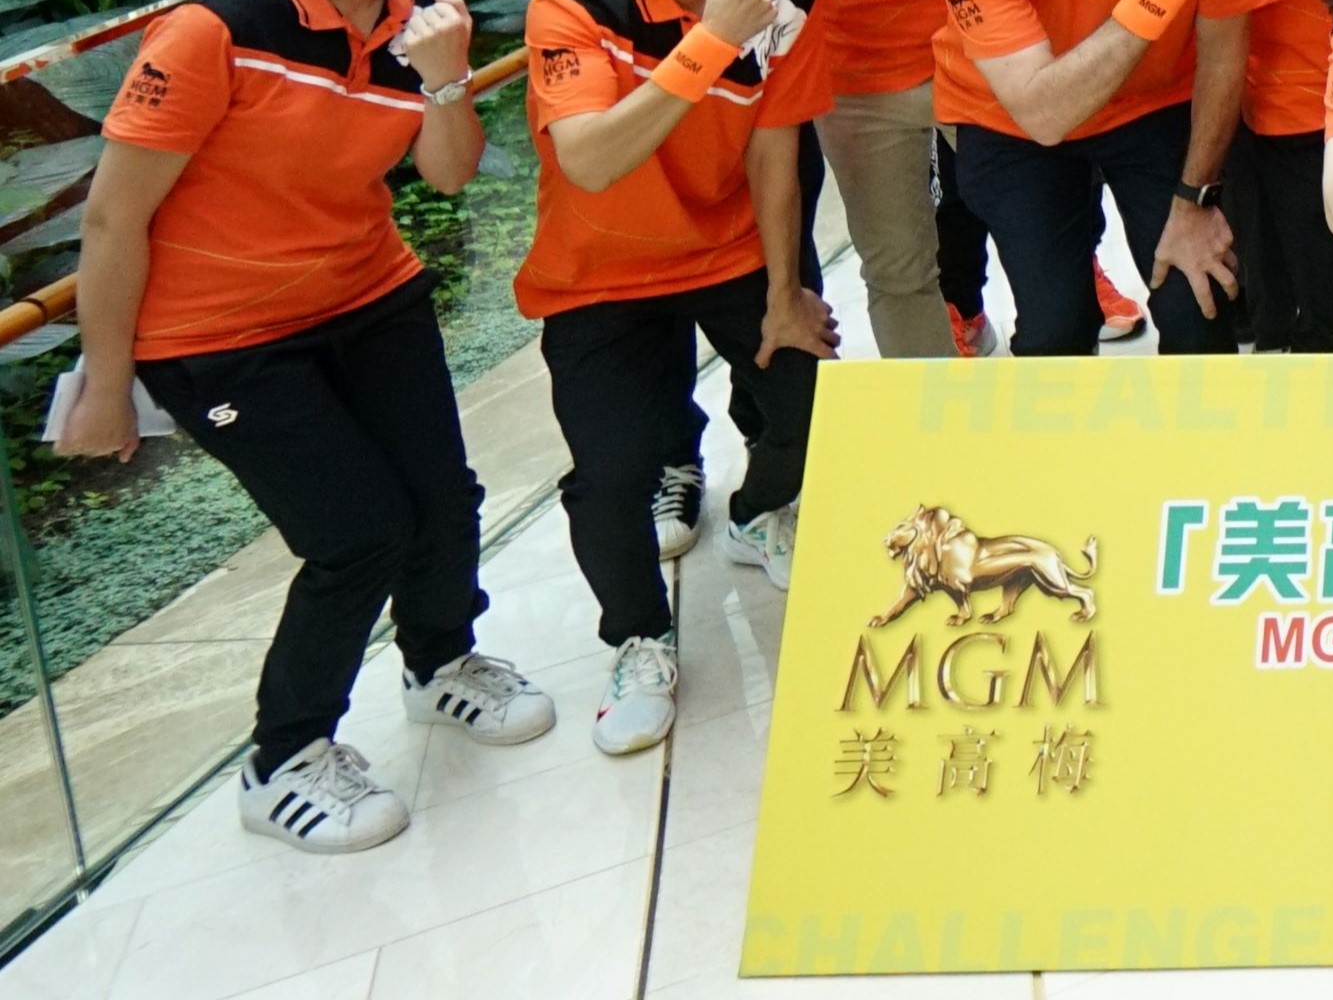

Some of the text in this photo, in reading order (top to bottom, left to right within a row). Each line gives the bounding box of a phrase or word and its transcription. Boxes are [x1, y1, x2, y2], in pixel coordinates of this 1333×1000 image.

[675, 51, 702, 74] MGM
[834, 630, 1106, 711] MGM
[831, 726, 1095, 797] 美高梅
